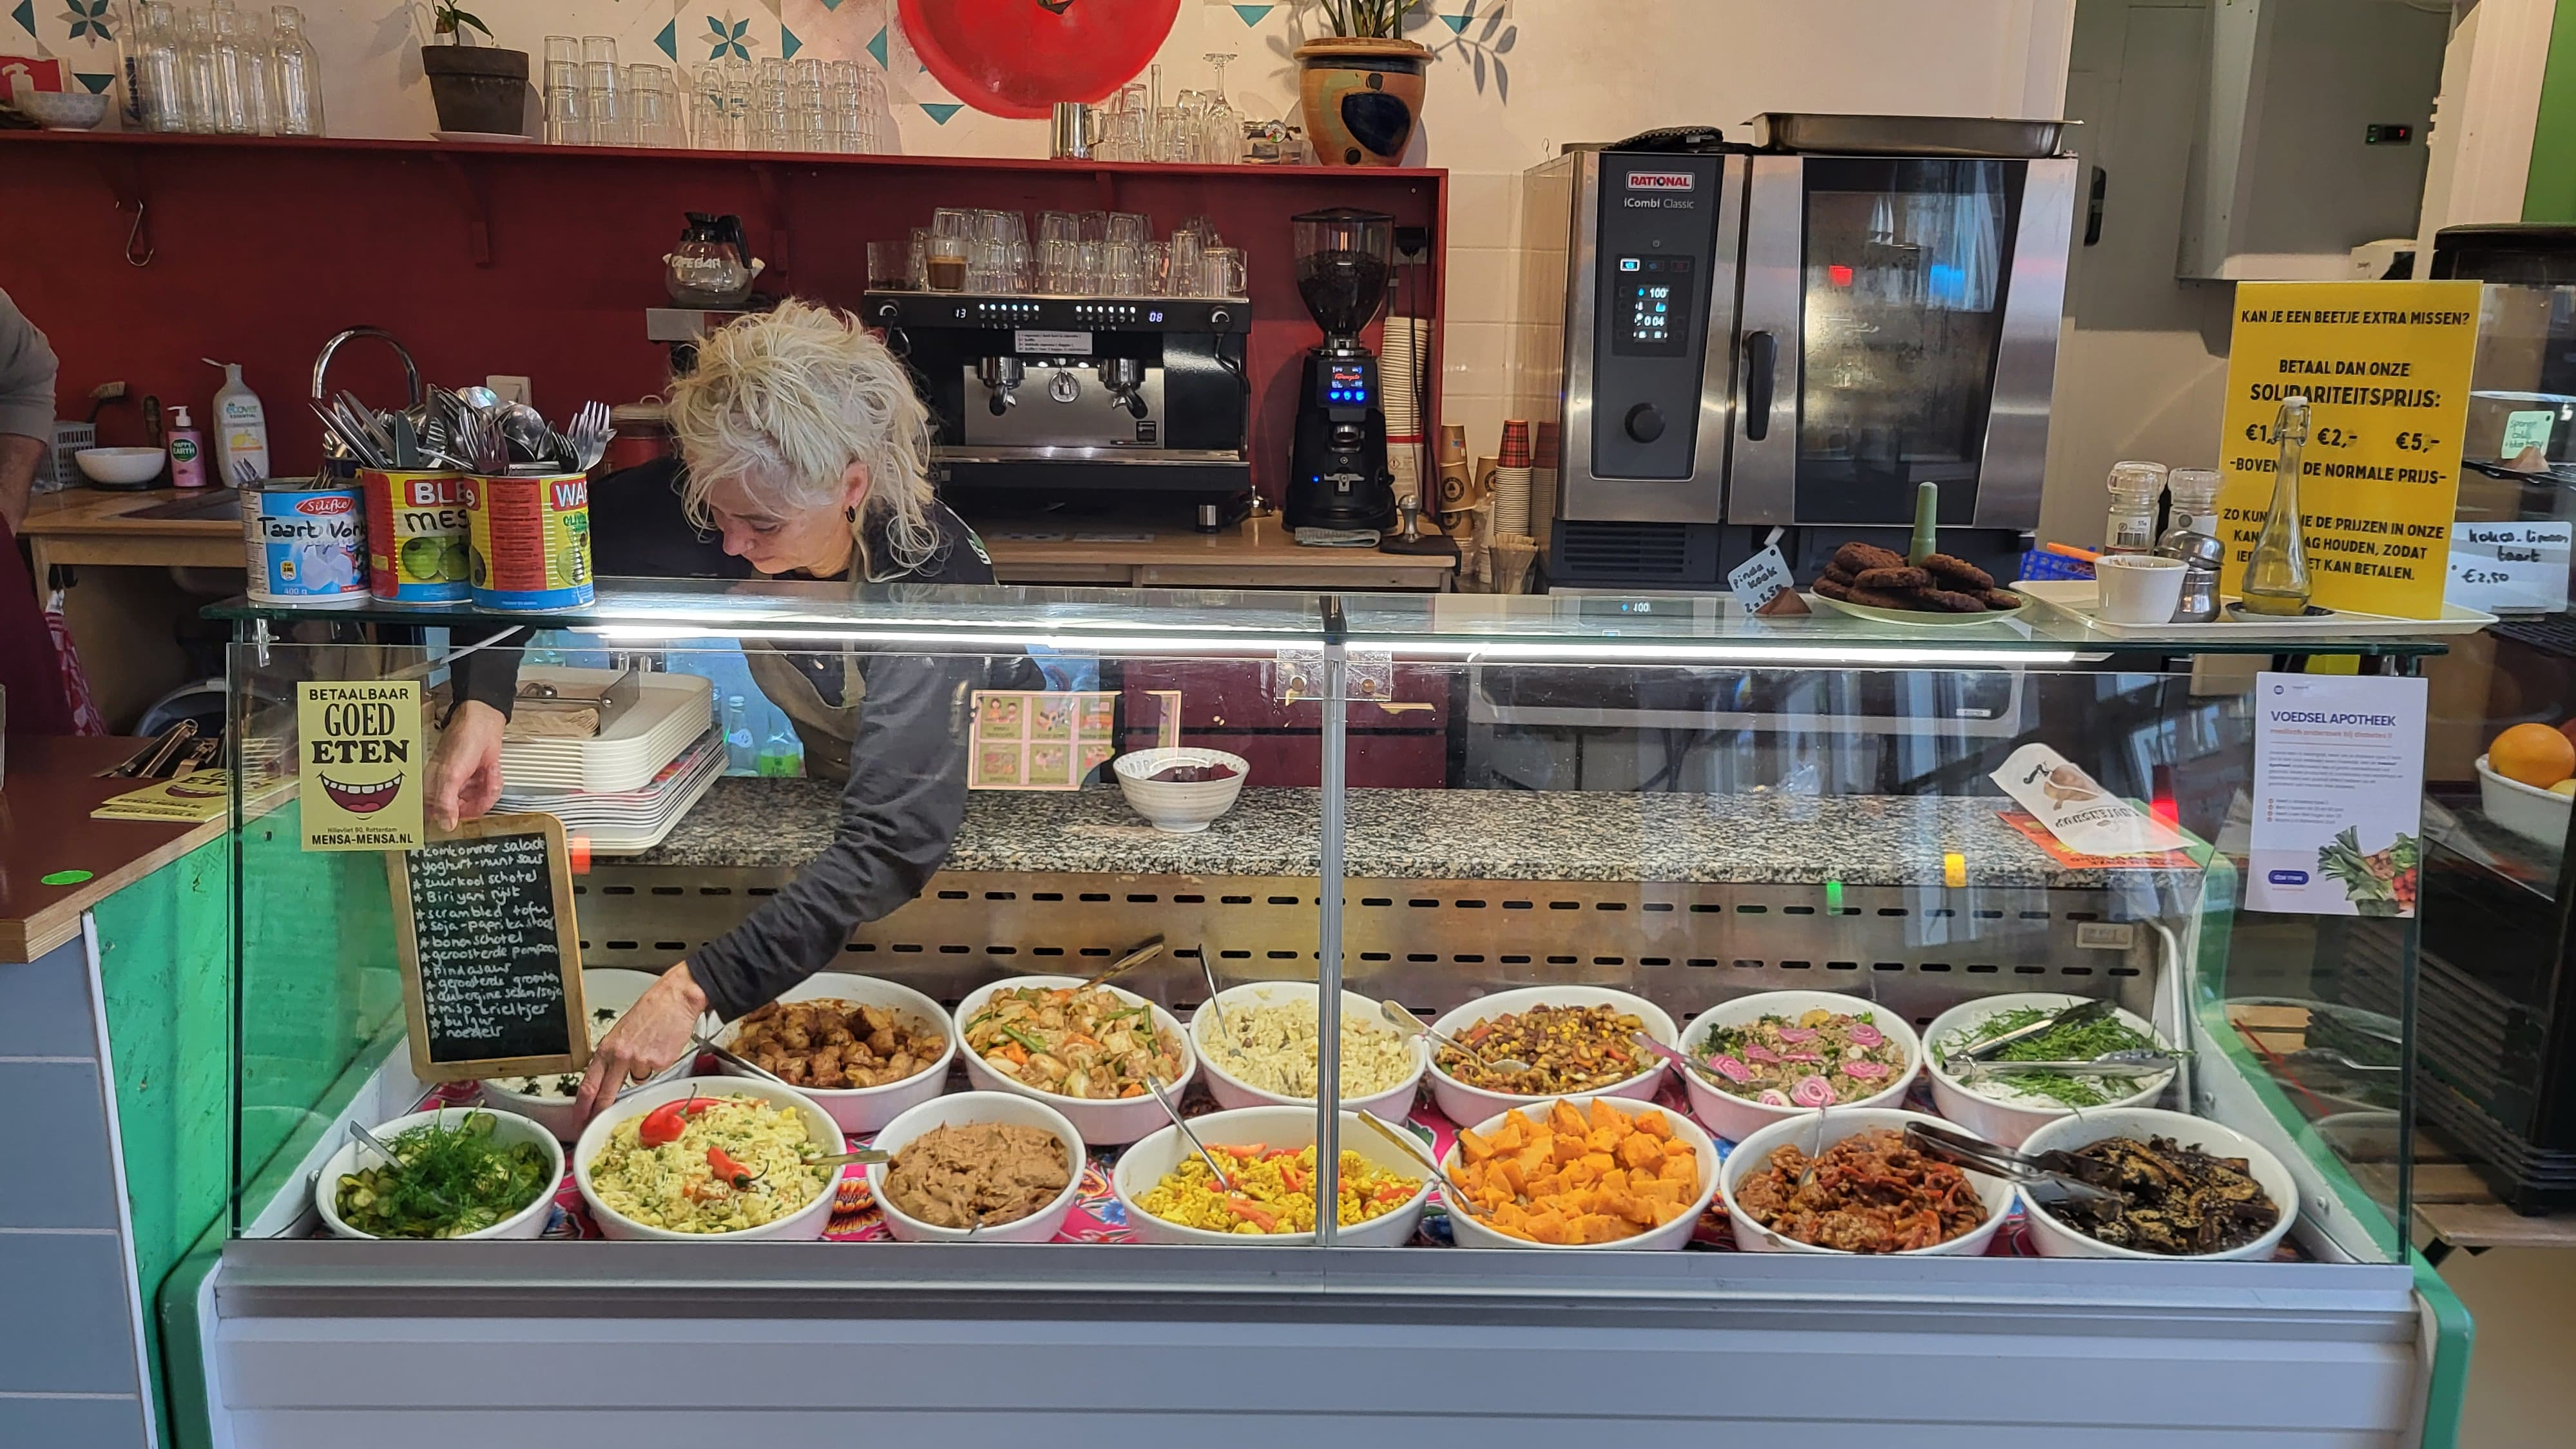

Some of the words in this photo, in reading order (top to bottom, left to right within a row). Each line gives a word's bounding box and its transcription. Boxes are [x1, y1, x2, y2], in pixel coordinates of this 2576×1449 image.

[1631, 176, 1690, 187] RATIONAL
[1624, 197, 1660, 209] iCombi
[1663, 198, 1695, 209] Classic
[695, 258, 721, 269] BAR
[954, 308, 966, 318] 13
[1149, 312, 1163, 322] 08
[2242, 310, 2267, 323] KAN
[2270, 311, 2284, 323] JE
[2286, 311, 2311, 324] EEN
[2314, 311, 2359, 324] BEETJE
[2363, 312, 2407, 325] EXTRA
[2410, 312, 2470, 325] MISSEN?
[2279, 360, 2331, 376] BETAAL
[2335, 361, 2365, 376] DAN
[2369, 362, 2411, 377] ONZE
[2250, 383, 2441, 408] SOLIDARITEITSPRIJS:
[2318, 428, 2358, 448] €2,-
[2396, 432, 2440, 454] €5,-
[2303, 462, 2322, 475] DE
[2325, 463, 2393, 481] NORMALE
[2398, 468, 2446, 485] PRIJS-
[307, 498, 349, 512] Silifke
[257, 516, 319, 539] Taart
[2224, 508, 2240, 521] ZO
[2243, 509, 2267, 523] KUN
[2316, 516, 2332, 529] DE
[2335, 517, 2387, 534] PRIJZEN
[2391, 523, 2404, 535] IN
[2407, 524, 2445, 540] ONZE
[2323, 539, 2379, 556] HOUDEN,
[2383, 544, 2428, 560] ZODAT
[2323, 560, 2351, 574] KAN
[2354, 564, 2415, 581] BETALEN.
[309, 688, 409, 700] BETAALBAAR
[324, 703, 395, 736] GOED
[2271, 710, 2327, 724] VOEDSEL
[2329, 713, 2396, 726] APOTHEEK
[311, 740, 410, 763] ETEN
[312, 833, 414, 845] MENSA-MENSA.NL
[488, 869, 537, 884] schotel
[427, 905, 503, 919] scrambled
[512, 901, 549, 923] tofu
